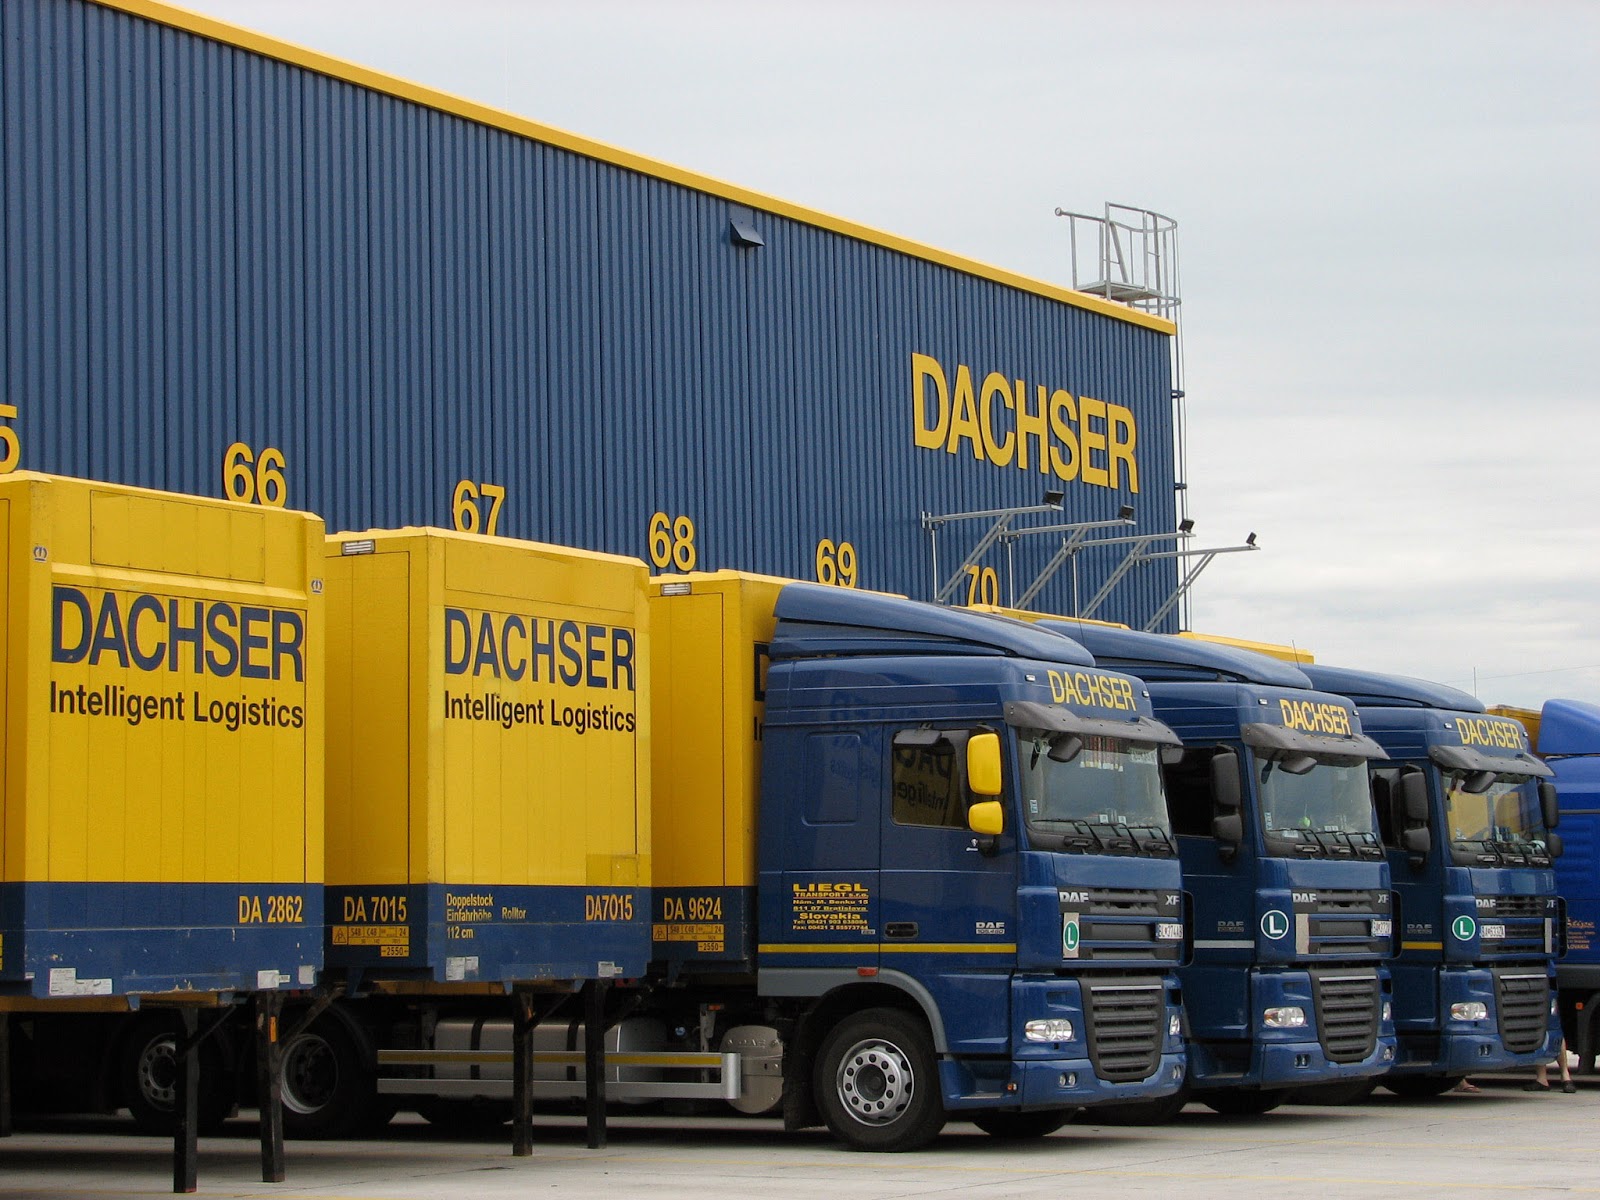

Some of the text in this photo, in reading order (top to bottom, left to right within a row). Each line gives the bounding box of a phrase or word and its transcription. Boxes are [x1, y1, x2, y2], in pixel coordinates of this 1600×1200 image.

[911, 352, 1139, 494] DACHSER
[223, 442, 287, 509] 66
[453, 480, 505, 535] 67
[649, 512, 696, 571] 68
[815, 538, 857, 588] 69
[964, 564, 998, 607] 70
[51, 586, 305, 682] DACHSER
[445, 607, 635, 691] DACHSER
[50, 681, 304, 732] Intelligent Logistics
[1047, 669, 1137, 712] DACHSER
[444, 690, 636, 735] Intelligent Logistics
[1279, 699, 1352, 736] DACHSER
[1455, 717, 1523, 750] DACHSER
[446, 893, 494, 909] Doppelstock
[793, 883, 868, 892] LIEGL
[1060, 892, 1089, 903] DAF
[1165, 895, 1180, 905] XF
[1292, 893, 1317, 903] DAF
[1476, 899, 1496, 909] DAF
[239, 895, 303, 923] DA 2862
[344, 896, 407, 922] DA 7015
[585, 894, 633, 921] DA7015
[664, 897, 722, 920] DA 9624
[447, 926, 474, 939] 112 cm
